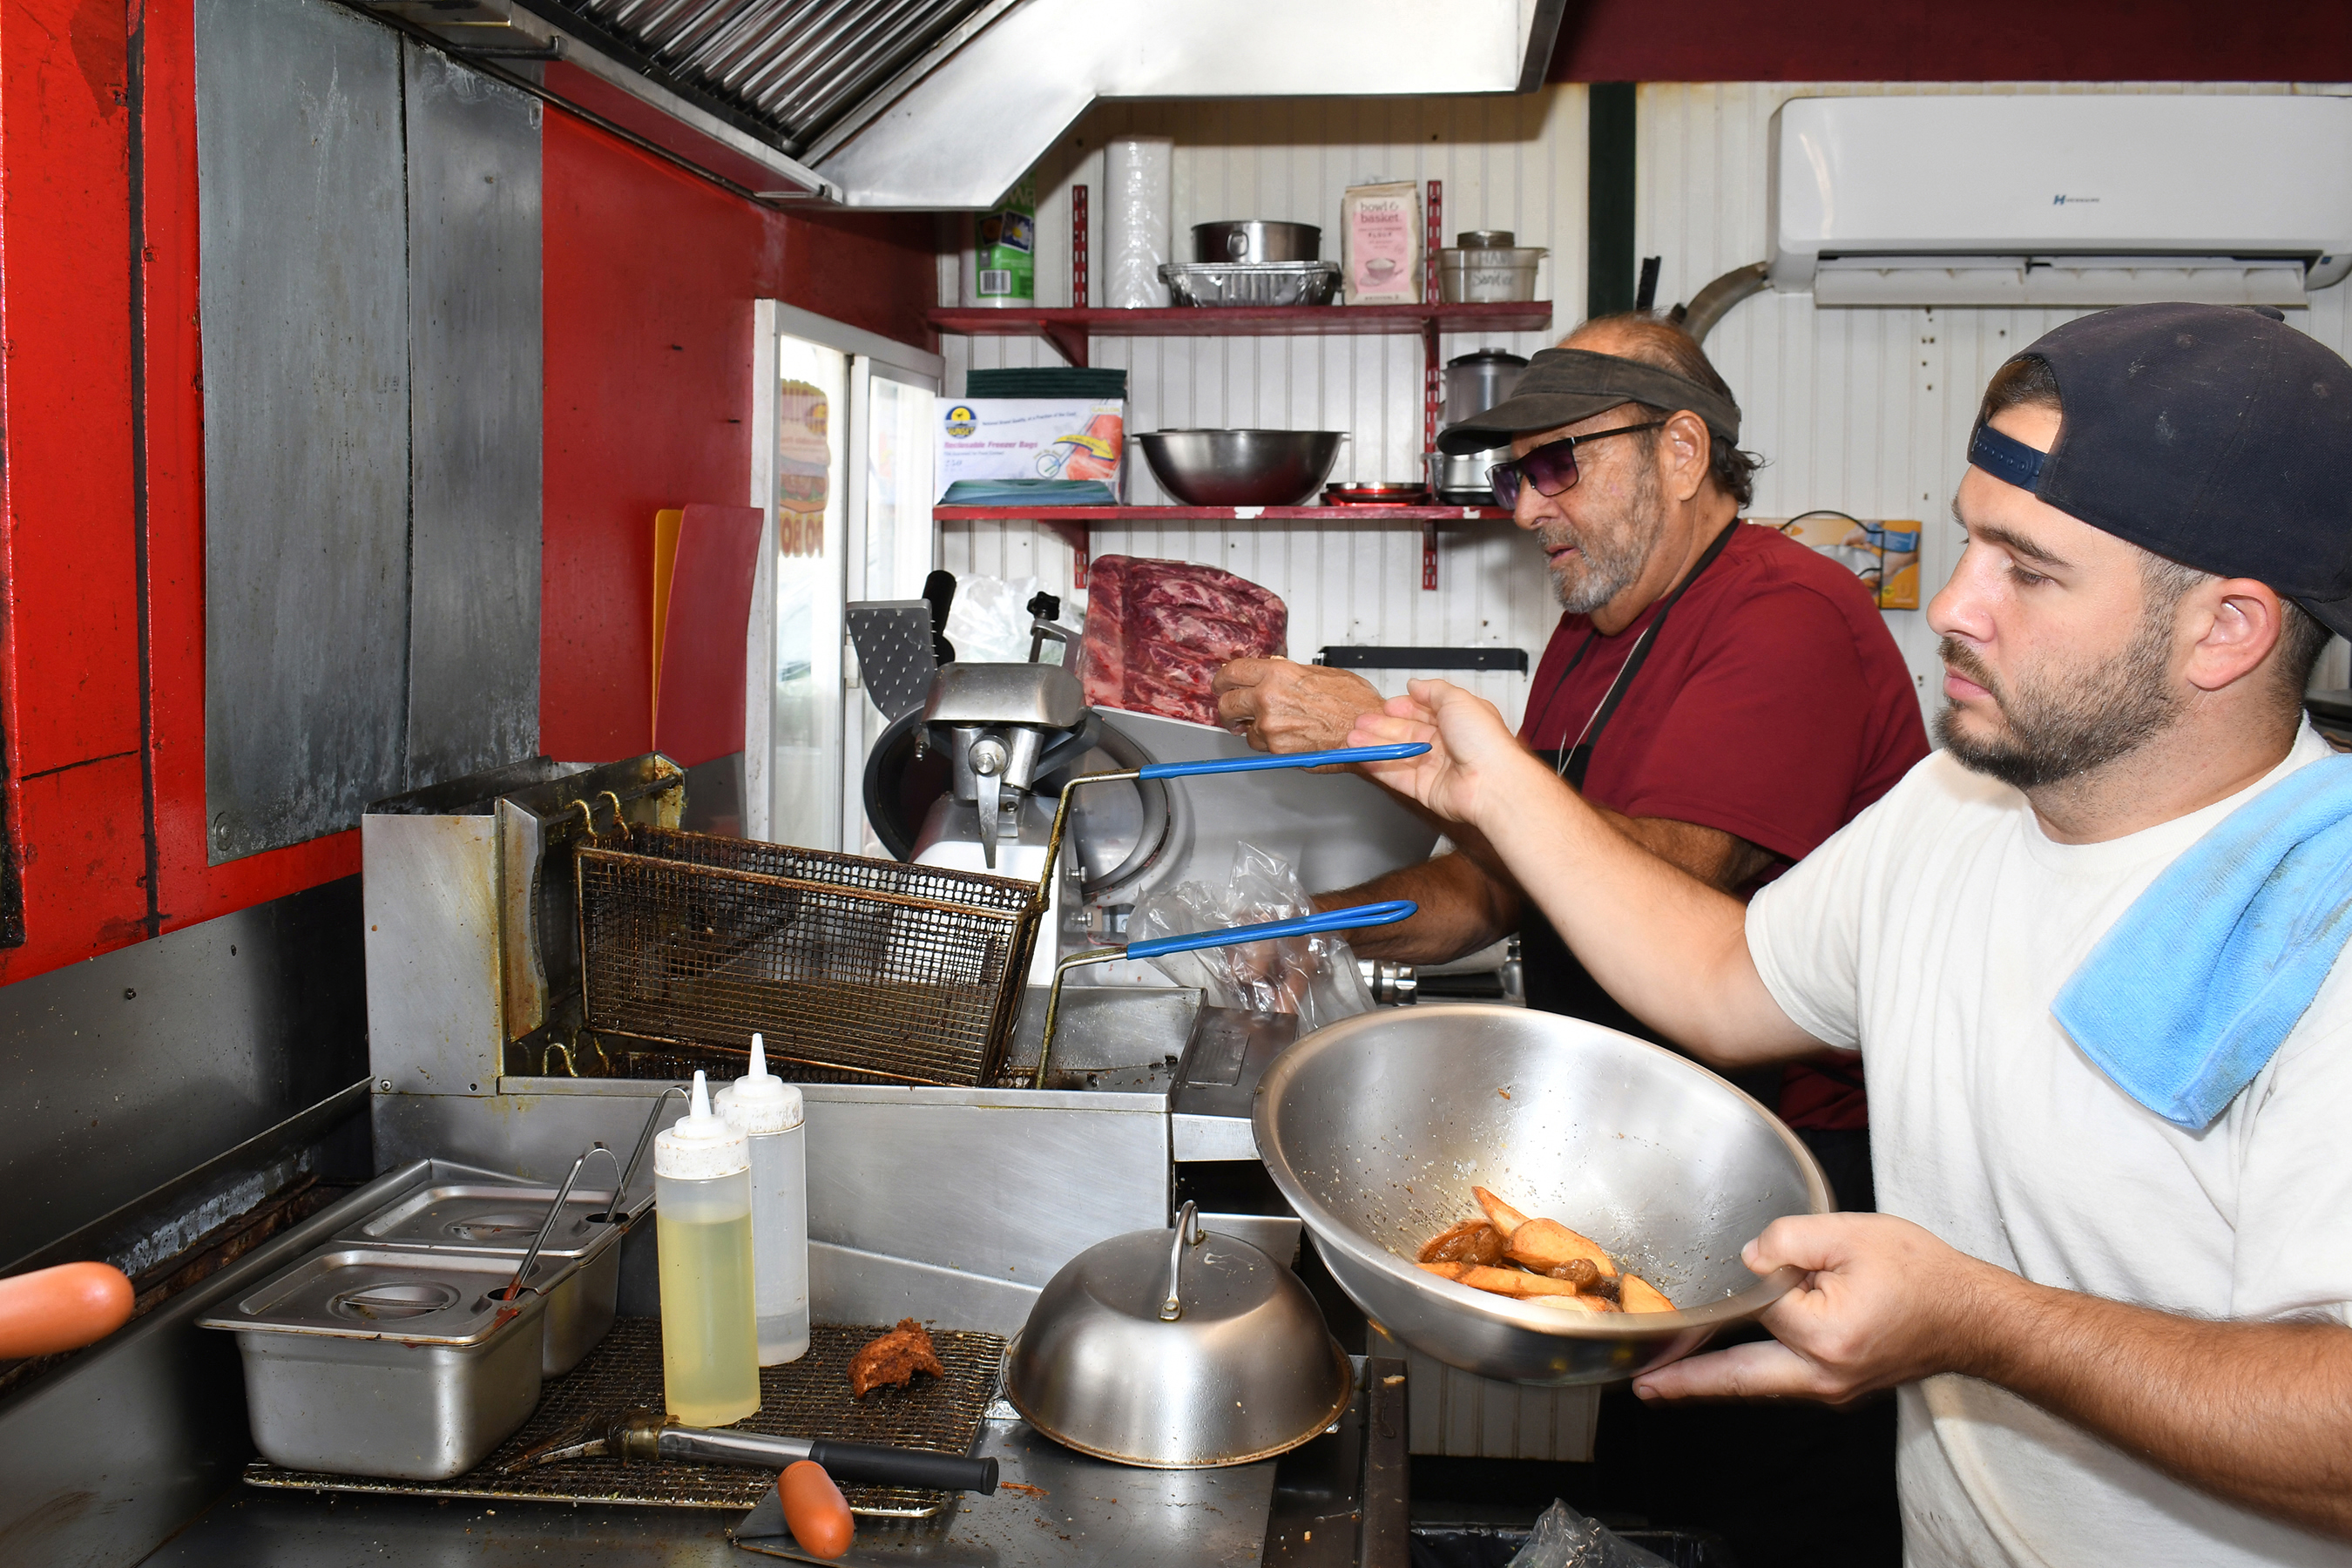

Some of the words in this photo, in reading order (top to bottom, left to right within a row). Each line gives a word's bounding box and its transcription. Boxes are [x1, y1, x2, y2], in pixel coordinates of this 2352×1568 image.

[1361, 201, 1387, 212] bowl
[1361, 213, 1399, 223] basket
[948, 427, 975, 436] SUNSET
[1019, 441, 1038, 449] Bags
